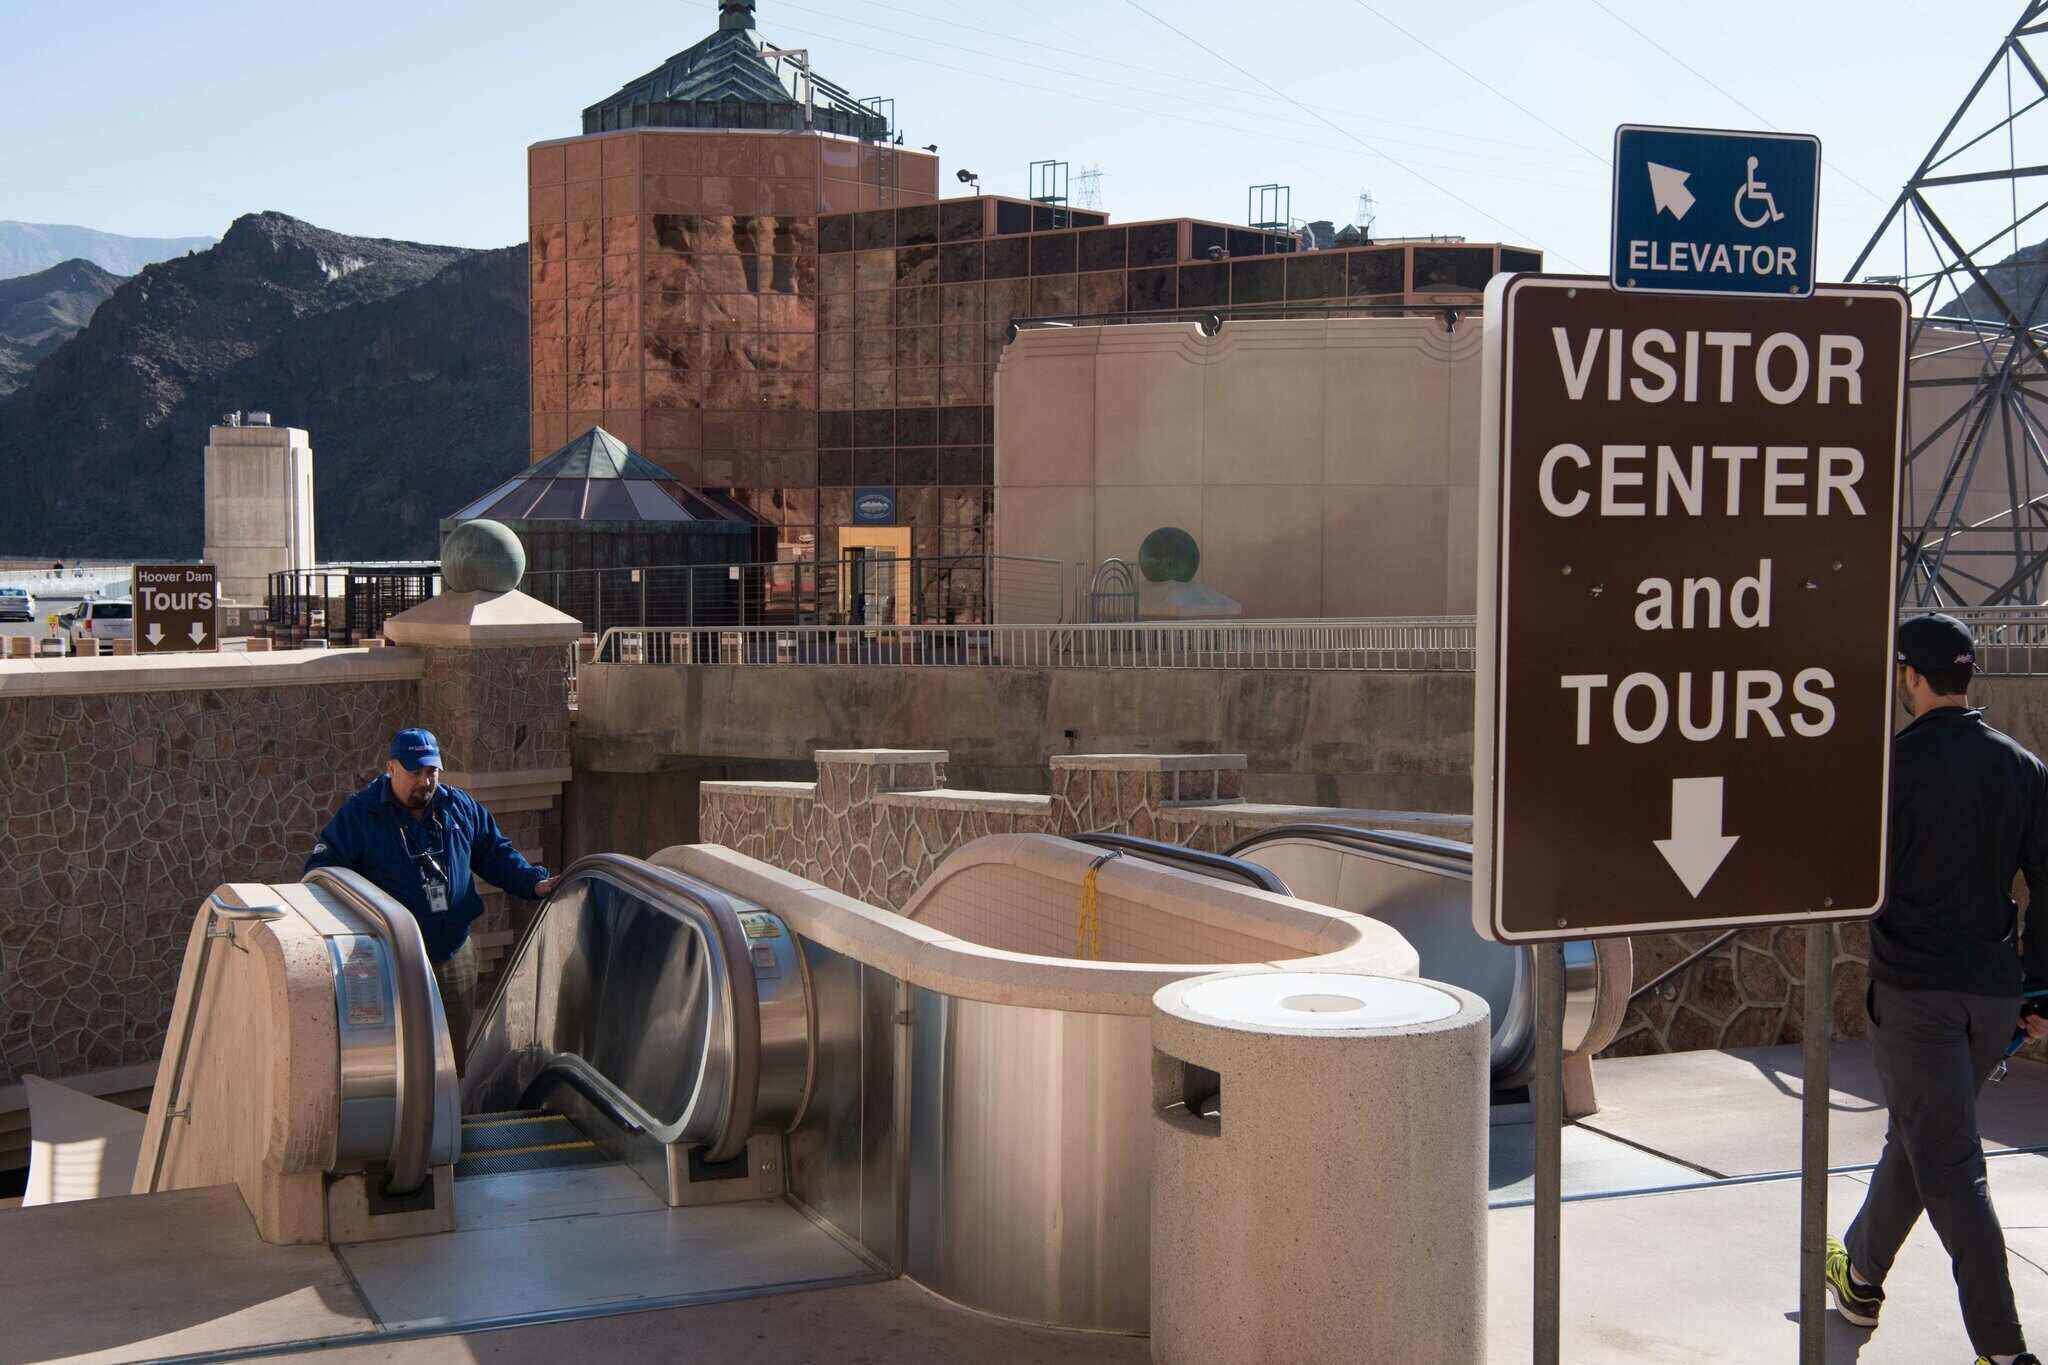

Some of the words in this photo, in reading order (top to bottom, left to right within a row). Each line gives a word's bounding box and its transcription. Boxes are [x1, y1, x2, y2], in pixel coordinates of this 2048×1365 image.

[1630, 239, 1798, 276] ELEVATOR
[1551, 326, 1864, 405] VISITOR
[1538, 443, 1867, 518] CENTER
[139, 571, 181, 582] Hoover
[186, 571, 212, 582] Dam
[139, 586, 213, 611] Tours
[1634, 558, 1772, 631] and
[1560, 667, 1836, 746] TOURS
